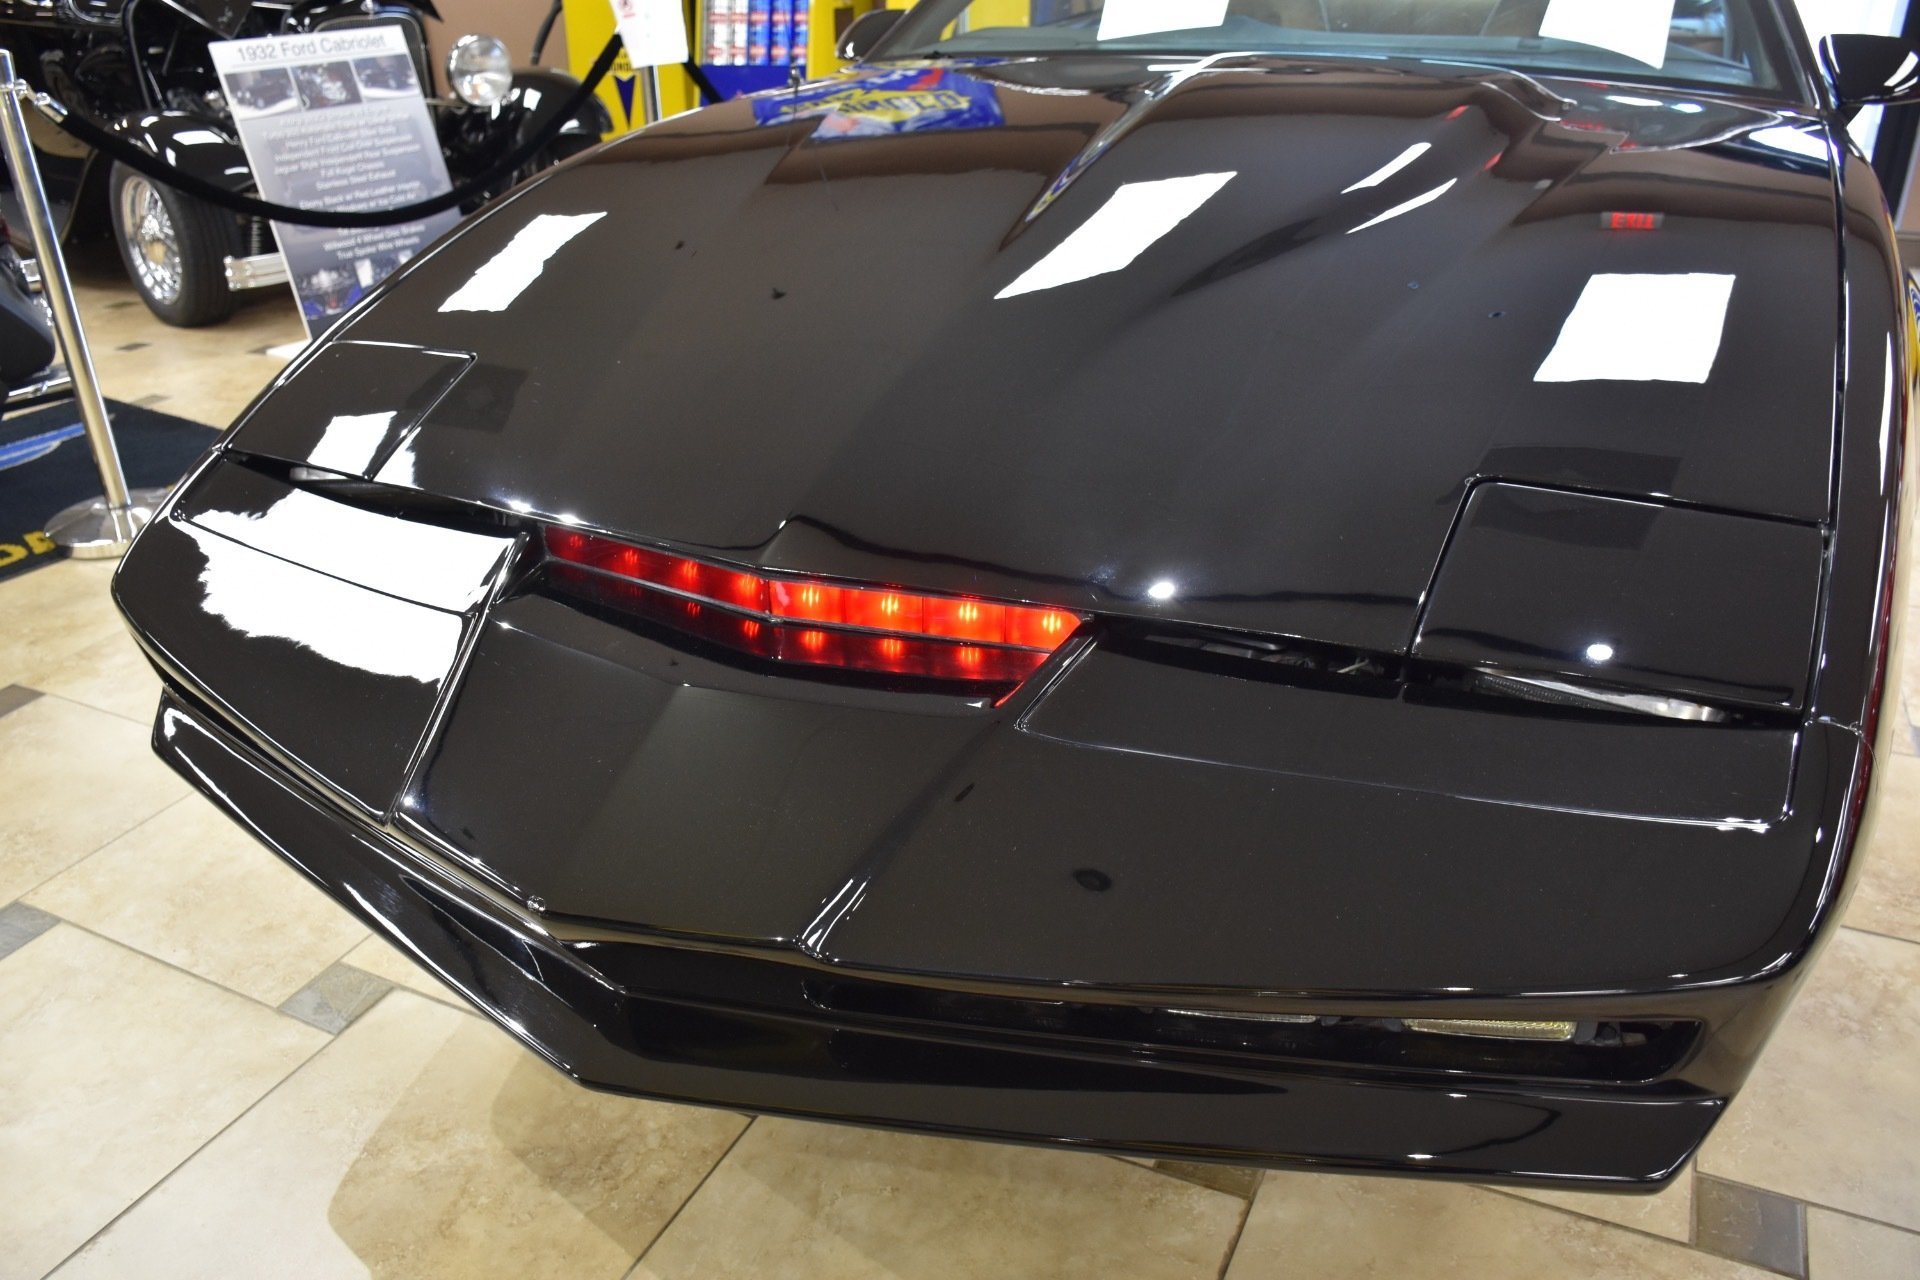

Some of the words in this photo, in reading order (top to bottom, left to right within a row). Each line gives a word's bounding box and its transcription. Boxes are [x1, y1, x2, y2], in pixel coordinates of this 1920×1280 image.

[238, 43, 277, 61] 1932
[280, 40, 318, 56] Ford
[319, 34, 387, 53] Cabriolet
